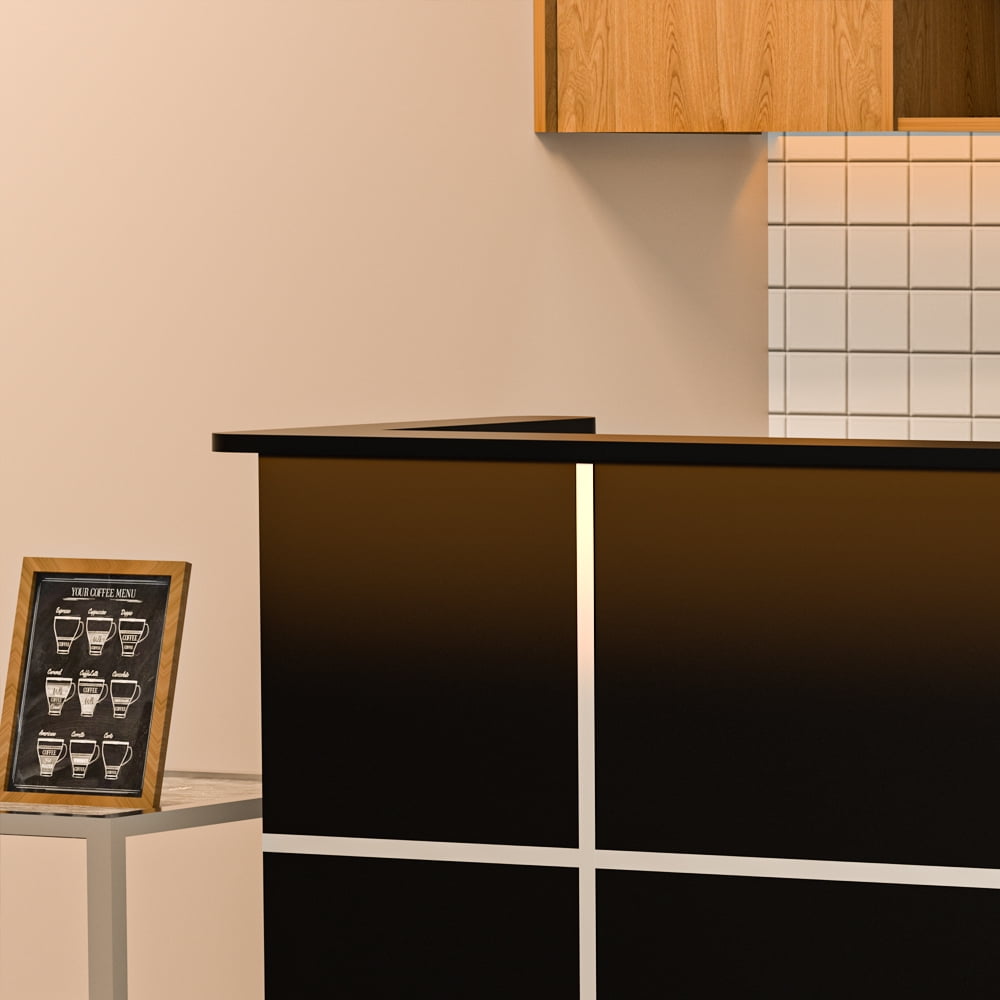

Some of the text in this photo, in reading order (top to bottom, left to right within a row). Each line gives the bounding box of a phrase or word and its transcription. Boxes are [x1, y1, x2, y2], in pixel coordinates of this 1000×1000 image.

[71, 587, 137, 599] YOUR COFFEE MENU
